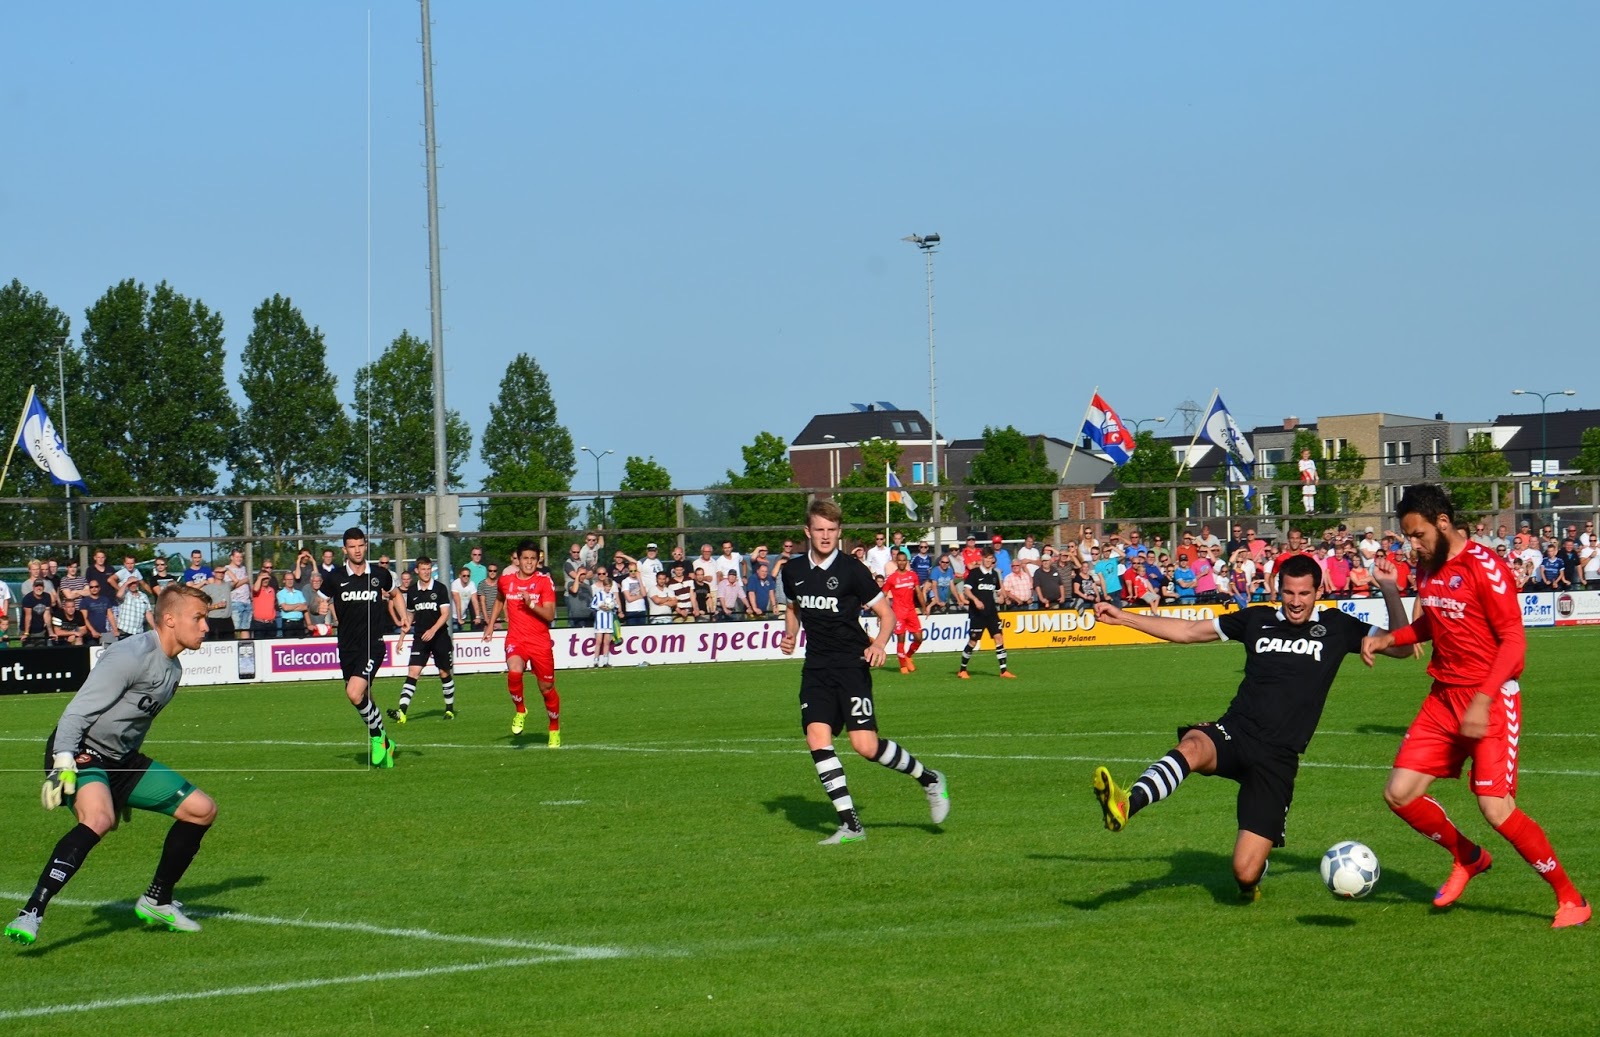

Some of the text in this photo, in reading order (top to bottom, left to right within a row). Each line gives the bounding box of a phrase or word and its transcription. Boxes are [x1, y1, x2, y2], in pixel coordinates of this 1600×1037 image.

[340, 590, 378, 602] CALOR
[1525, 595, 1538, 605] GO
[1139, 607, 1214, 620] MBO
[1341, 602, 1356, 613] GO
[1523, 605, 1551, 616] SPORT
[1014, 611, 1097, 634] JUMBO
[697, 622, 806, 660] specia
[1052, 635, 1067, 644] Nap
[199, 644, 212, 657] bij
[214, 646, 234, 654] een
[452, 642, 492, 659] hone
[1255, 637, 1324, 662] CALOR
[365, 659, 375, 672] 5
[851, 697, 873, 717] 20
